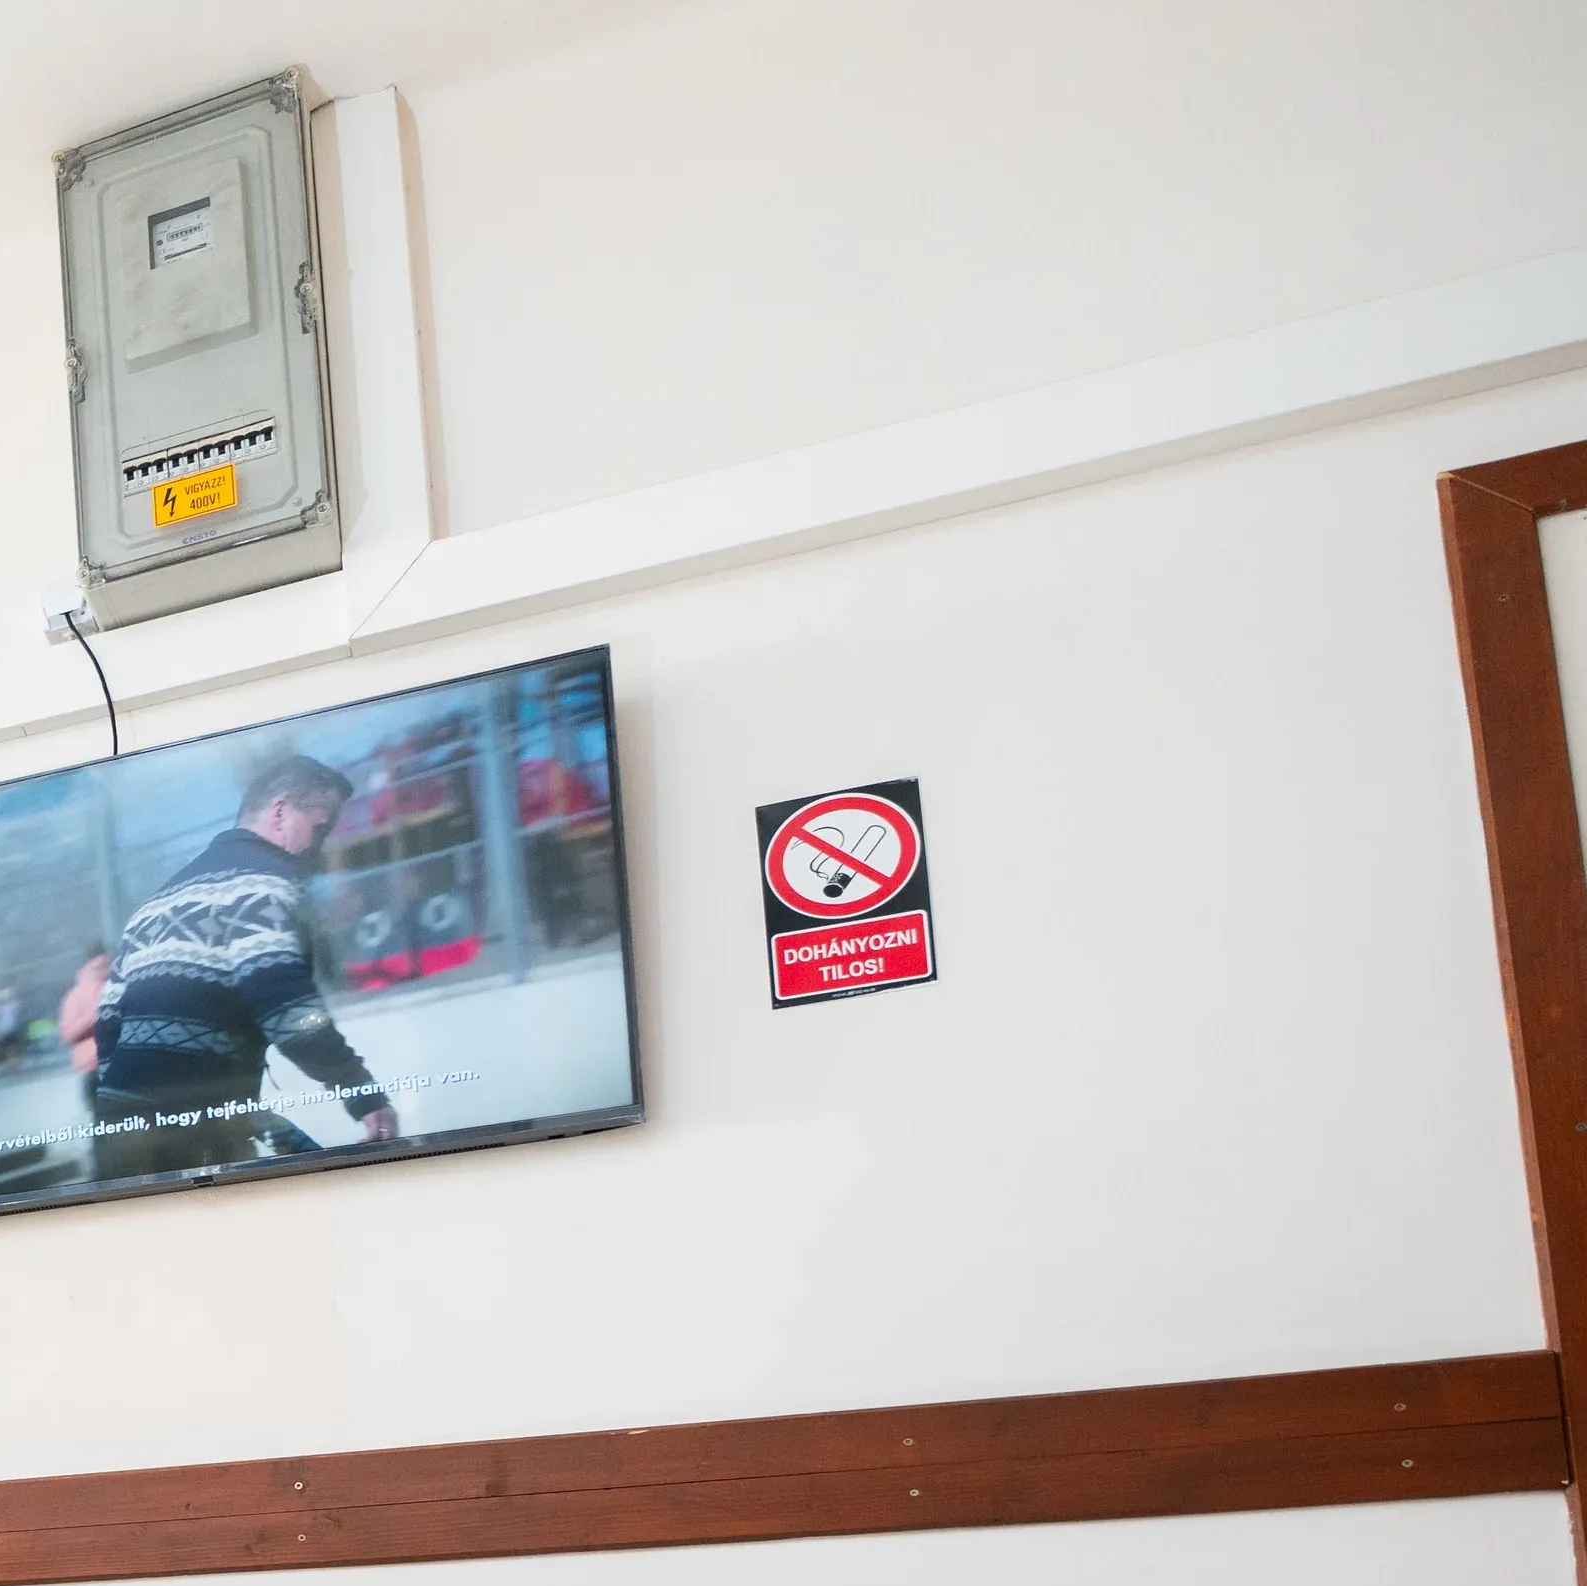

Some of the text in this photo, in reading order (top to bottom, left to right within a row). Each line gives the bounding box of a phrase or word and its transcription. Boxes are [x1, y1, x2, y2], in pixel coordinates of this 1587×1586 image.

[189, 492, 221, 510] 400V!
[783, 928, 919, 965] DOHÁNYOZNI
[818, 957, 885, 982] TILOS!
[77, 1114, 150, 1139] kiderült,
[155, 1109, 202, 1129] hogy
[206, 1095, 295, 1121] tejfehérje
[301, 1075, 432, 1106] intoleranciája
[439, 1068, 480, 1085] van.
